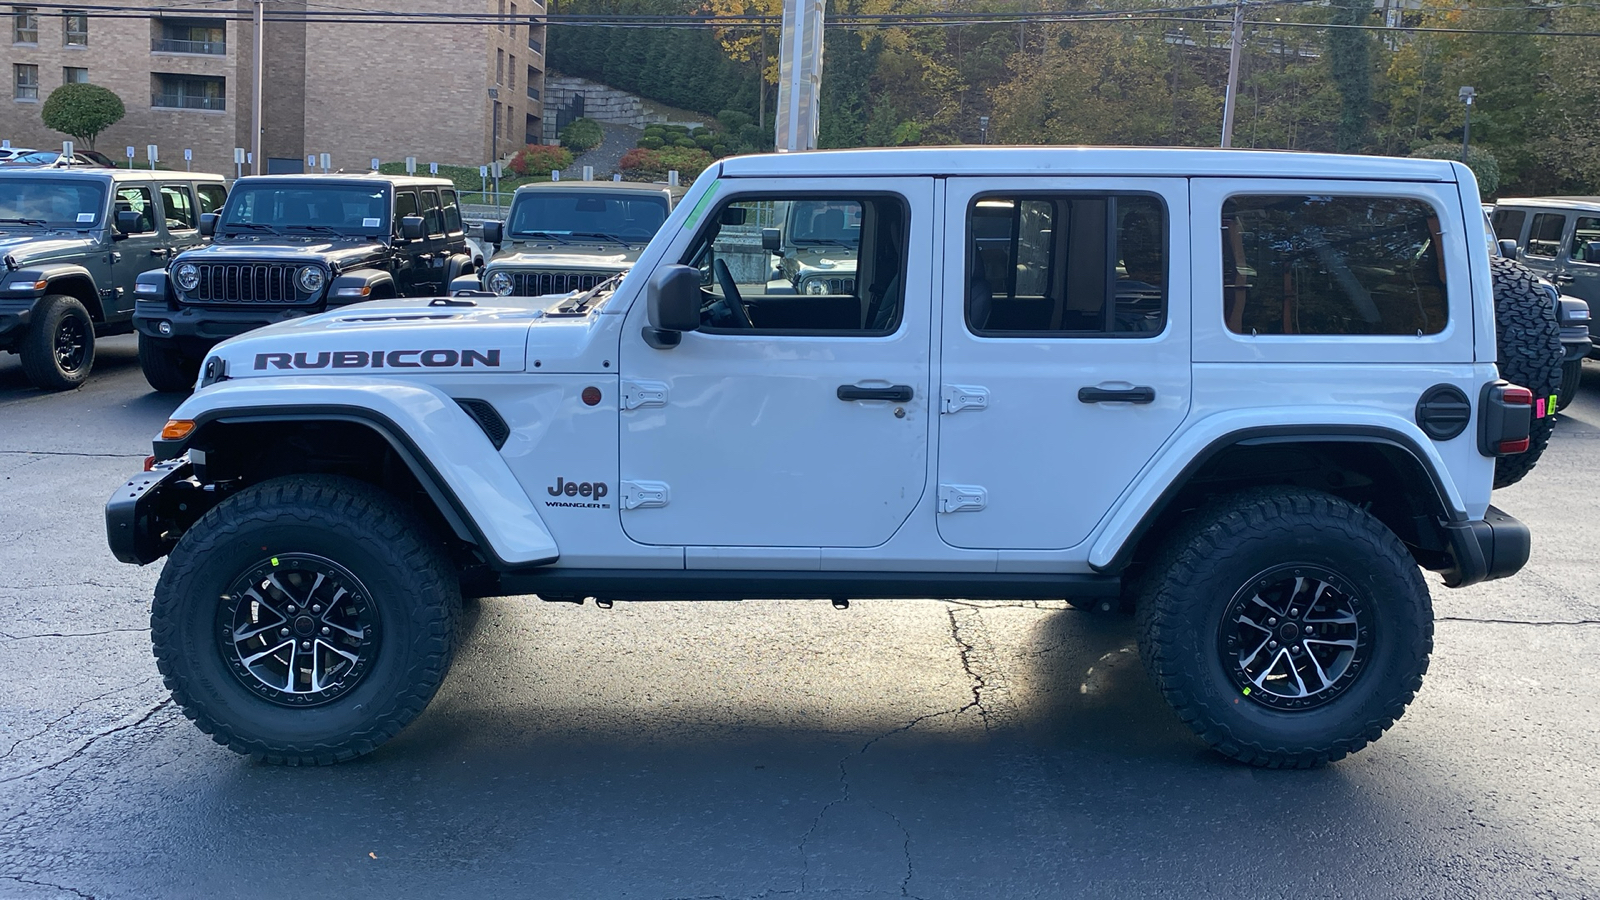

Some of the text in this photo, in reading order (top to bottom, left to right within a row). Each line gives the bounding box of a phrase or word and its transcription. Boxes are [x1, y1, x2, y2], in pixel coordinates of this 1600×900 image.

[253, 349, 501, 370] RUBICON
[547, 476, 608, 501] Jeep
[545, 501, 600, 509] WRANGLER
